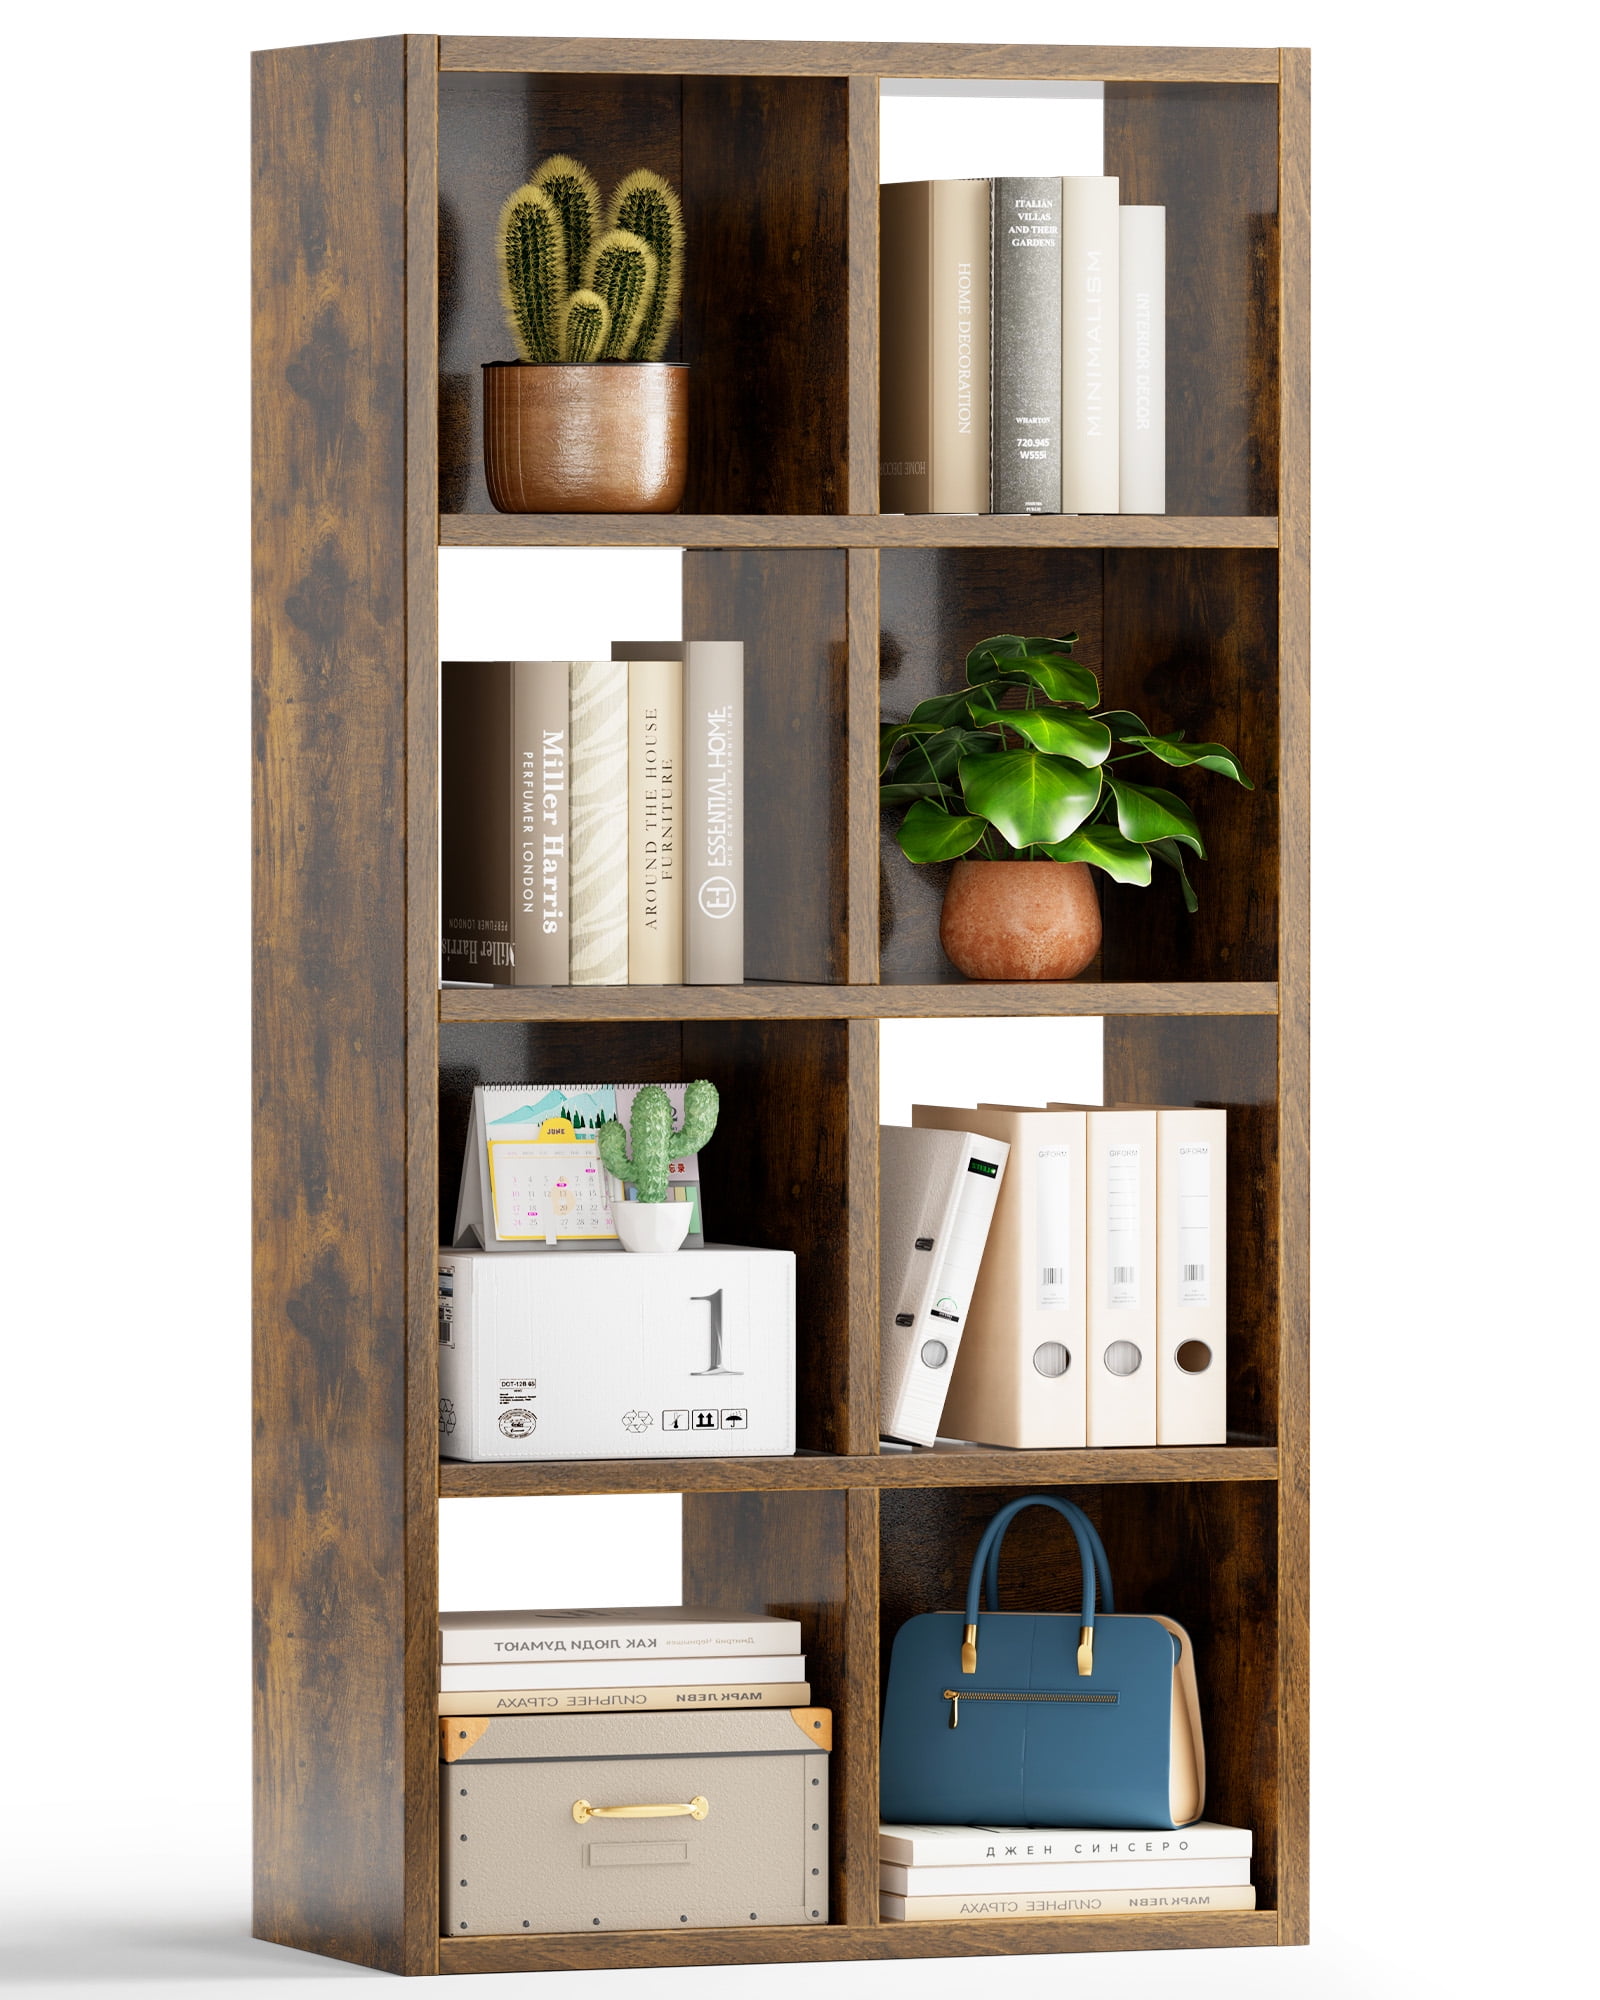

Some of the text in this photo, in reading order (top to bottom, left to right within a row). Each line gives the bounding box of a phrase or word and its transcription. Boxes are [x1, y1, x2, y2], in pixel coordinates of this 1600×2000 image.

[1008, 225, 1058, 234] AND THEIR
[1011, 238, 1056, 247] GARDENS
[1015, 199, 1053, 208] ITALIAN
[1017, 212, 1052, 221] VILLAS
[959, 262, 971, 434] HOME DECORATION
[1087, 251, 1102, 437] MINIMALISM
[1135, 292, 1150, 430] INTERIOR DECOR
[1016, 438, 1050, 447] 720.945
[523, 752, 533, 913] PERFUMER LONDON
[542, 730, 564, 934] Miller Harris
[645, 708, 657, 930] AROUND THE HOUSE
[661, 759, 673, 880] FURNITURE
[707, 706, 726, 867] ESSENTIAL HOME
[689, 1287, 745, 1376] 1
[986, 1841, 1189, 1858] ДЖЕН СИНСЕРО
